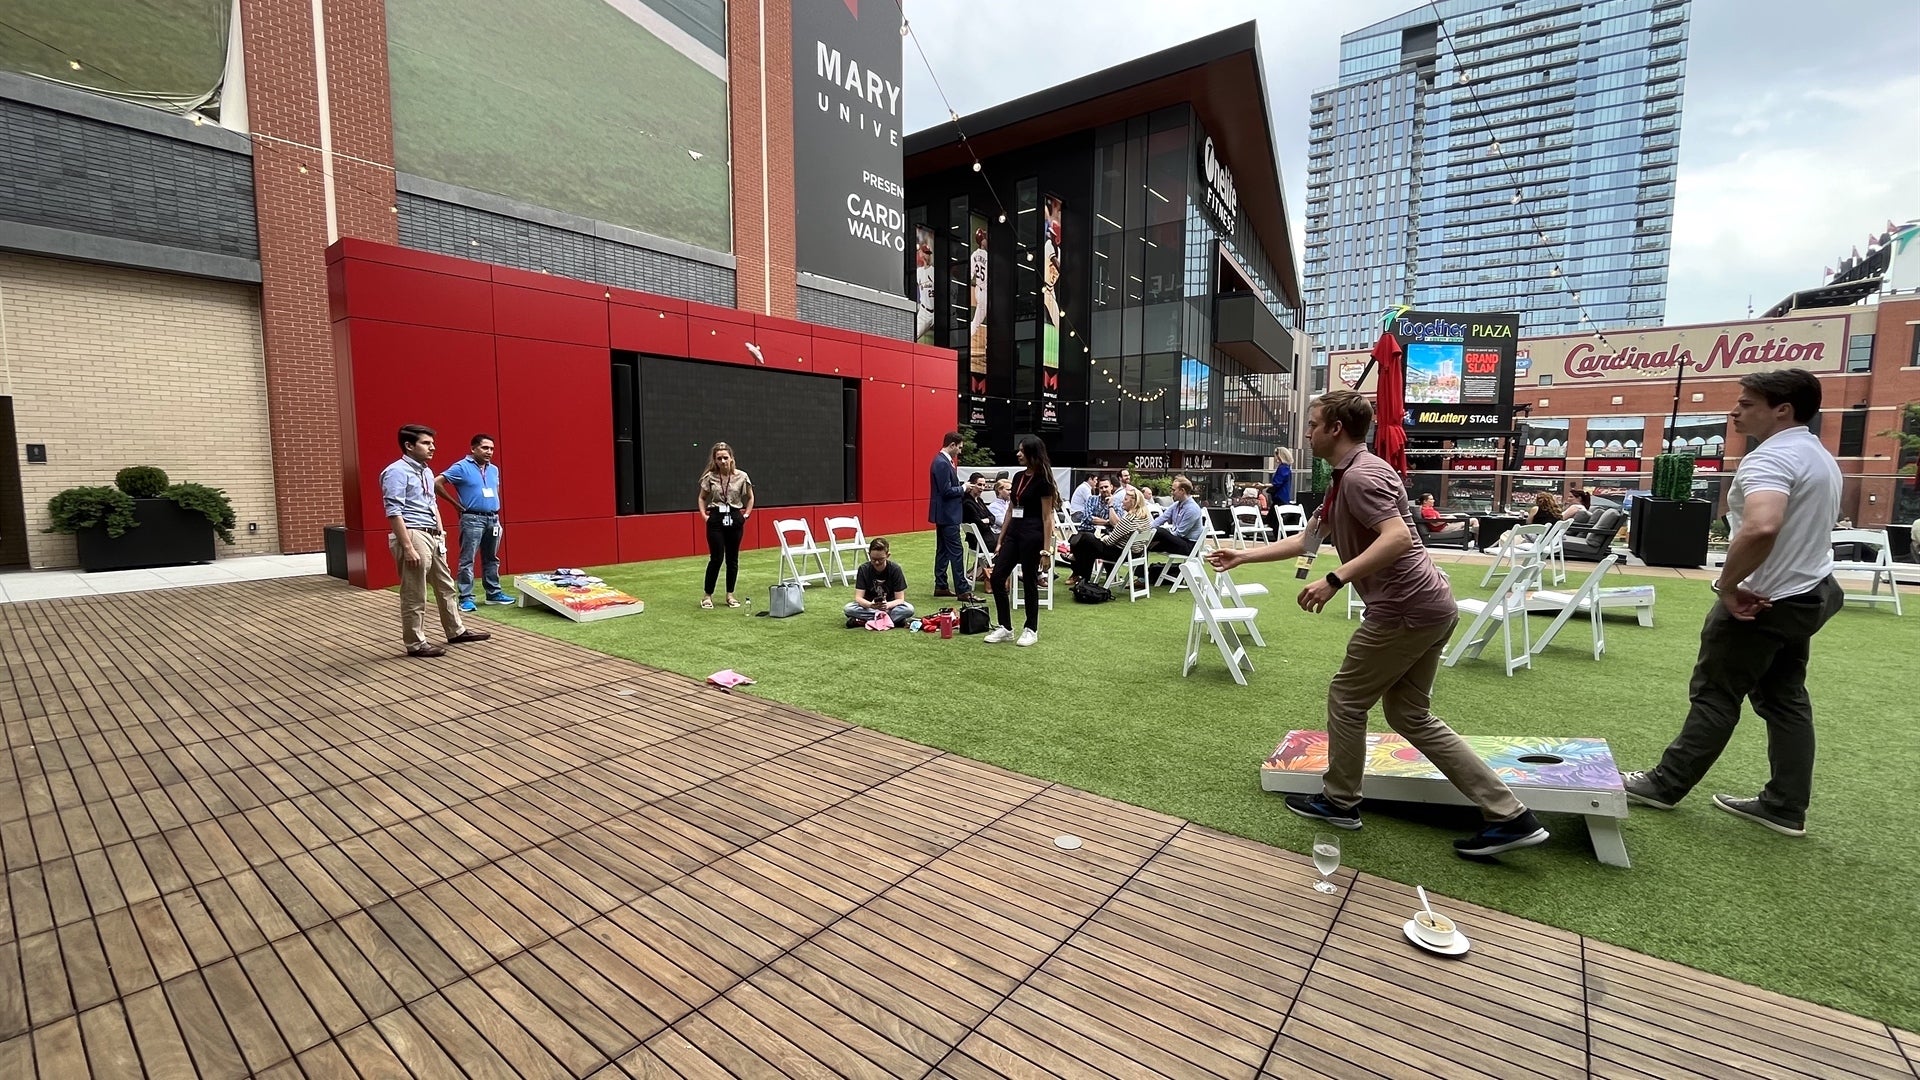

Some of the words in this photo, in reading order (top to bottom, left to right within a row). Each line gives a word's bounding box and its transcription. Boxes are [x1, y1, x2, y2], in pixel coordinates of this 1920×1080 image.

[817, 40, 900, 116] MARY
[818, 92, 898, 147] UNIVE
[1204, 136, 1237, 217] Onelife
[1206, 186, 1235, 236] FITNESS
[848, 217, 891, 248] WALK
[1395, 317, 1467, 341] Together
[1472, 324, 1512, 338] PLAZA
[1465, 353, 1499, 364] GRAND
[1467, 363, 1495, 373] SLAM
[1564, 343, 1697, 378] Cardinals
[1694, 332, 1826, 372] Nation
[1419, 412, 1468, 426] MOLottery
[1469, 415, 1499, 424] STAGE
[1134, 455, 1163, 469] SPORTS
